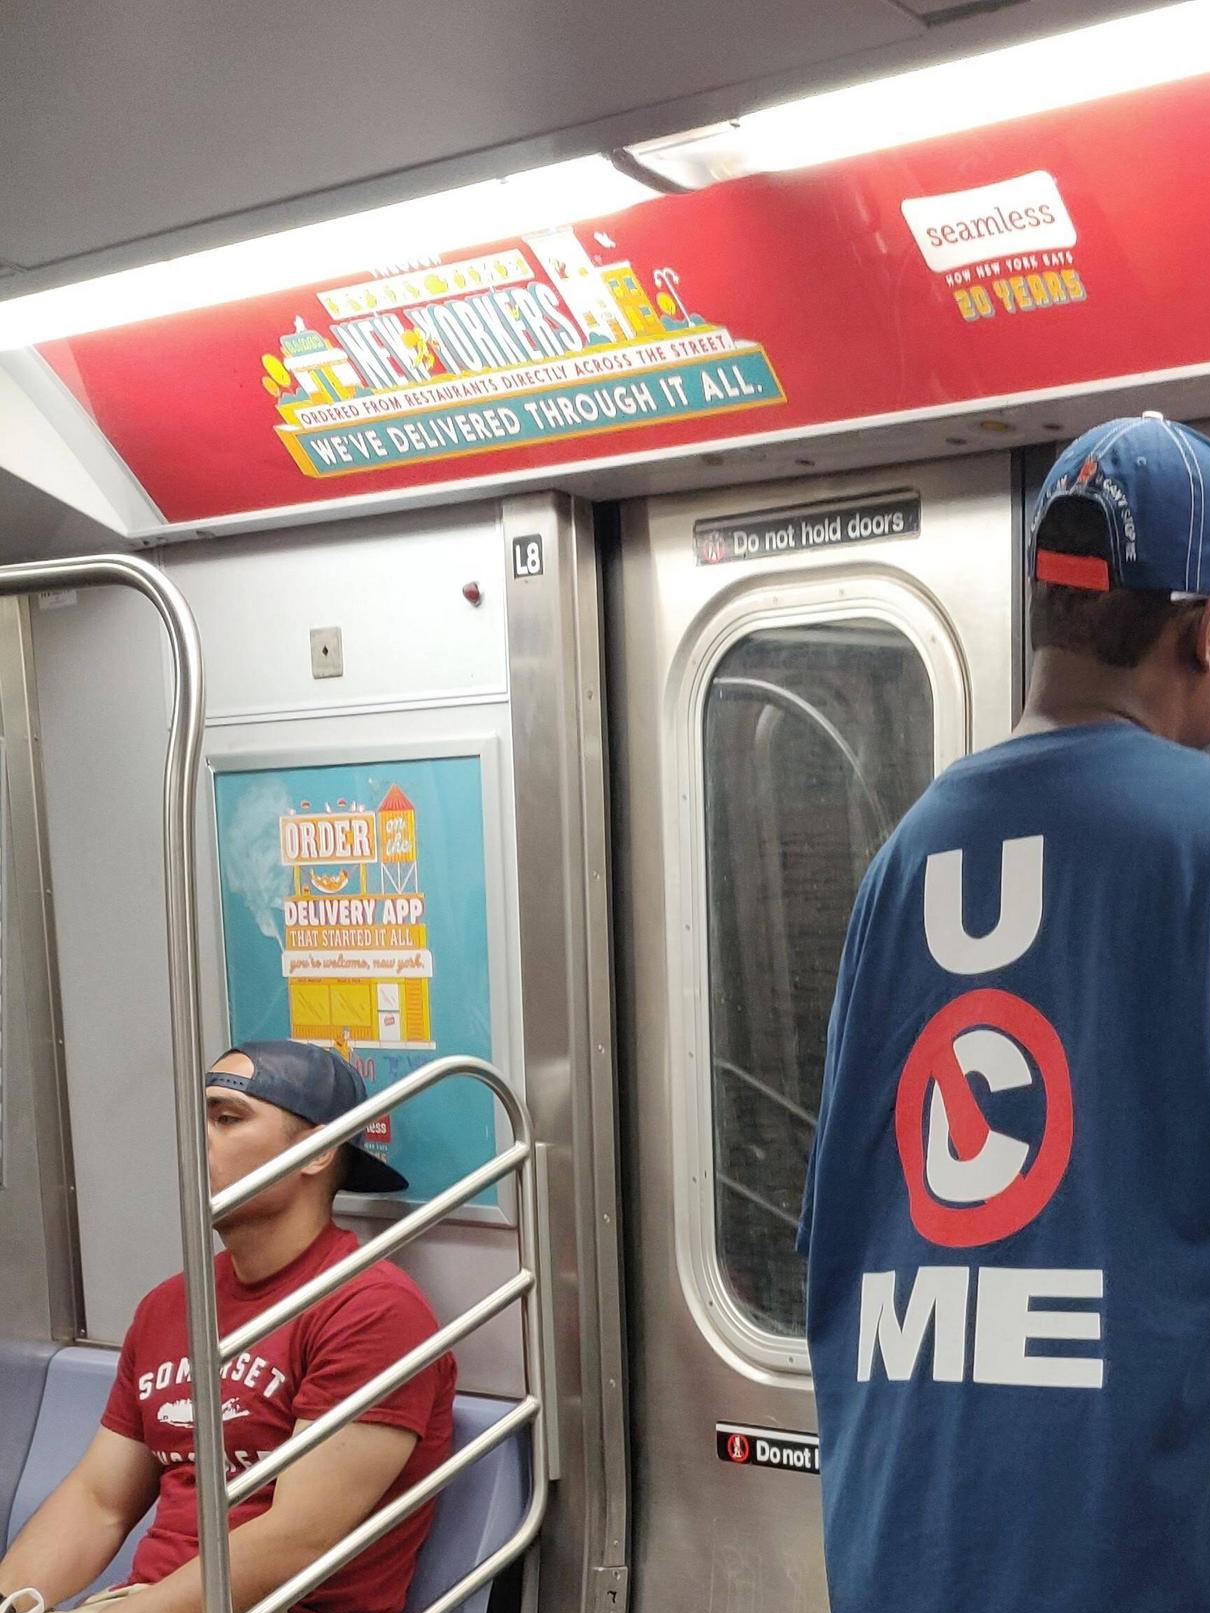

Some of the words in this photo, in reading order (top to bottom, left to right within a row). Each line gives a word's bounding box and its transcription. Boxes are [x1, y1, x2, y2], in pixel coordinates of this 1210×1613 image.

[926, 204, 1055, 246] seamless
[945, 269, 971, 287] HOW
[976, 262, 1000, 279] NEW
[1006, 256, 1038, 272] YORK
[1042, 251, 1073, 266] EATS
[953, 285, 995, 322] 20
[992, 268, 1087, 314] YEARS
[333, 314, 432, 390] NEW
[405, 283, 583, 376] YORKERS
[301, 400, 360, 425] ORDERED
[363, 396, 401, 416] FROM
[404, 378, 498, 406] RESTAURANTS
[503, 365, 567, 389] DIRECTLY
[574, 355, 631, 376] ACROSS
[636, 348, 667, 366] THE
[310, 429, 388, 466] WE'VE
[387, 407, 521, 453] DELIVERED
[524, 382, 657, 430] THROUGH
[659, 375, 689, 407] IT
[702, 365, 763, 401] ALL.
[733, 530, 760, 555] Do
[765, 525, 796, 551] not
[801, 517, 841, 546] hold
[847, 512, 904, 539] doors
[515, 541, 540, 576] L8
[285, 819, 371, 859] ORDER
[386, 816, 406, 833] on
[285, 899, 376, 926] DELIVERY
[383, 898, 423, 925] APP
[923, 833, 1045, 976] U
[290, 931, 319, 947] THAT
[322, 929, 372, 947] STARTED
[375, 929, 386, 946] IT
[390, 929, 413, 946] ALL
[290, 954, 322, 974] you're
[322, 953, 371, 970] welcome,
[373, 959, 396, 969] new
[926, 1028, 1034, 1203] C
[856, 1265, 1104, 1389] ME
[756, 1440, 780, 1464] Do
[783, 1448, 811, 1469] not
